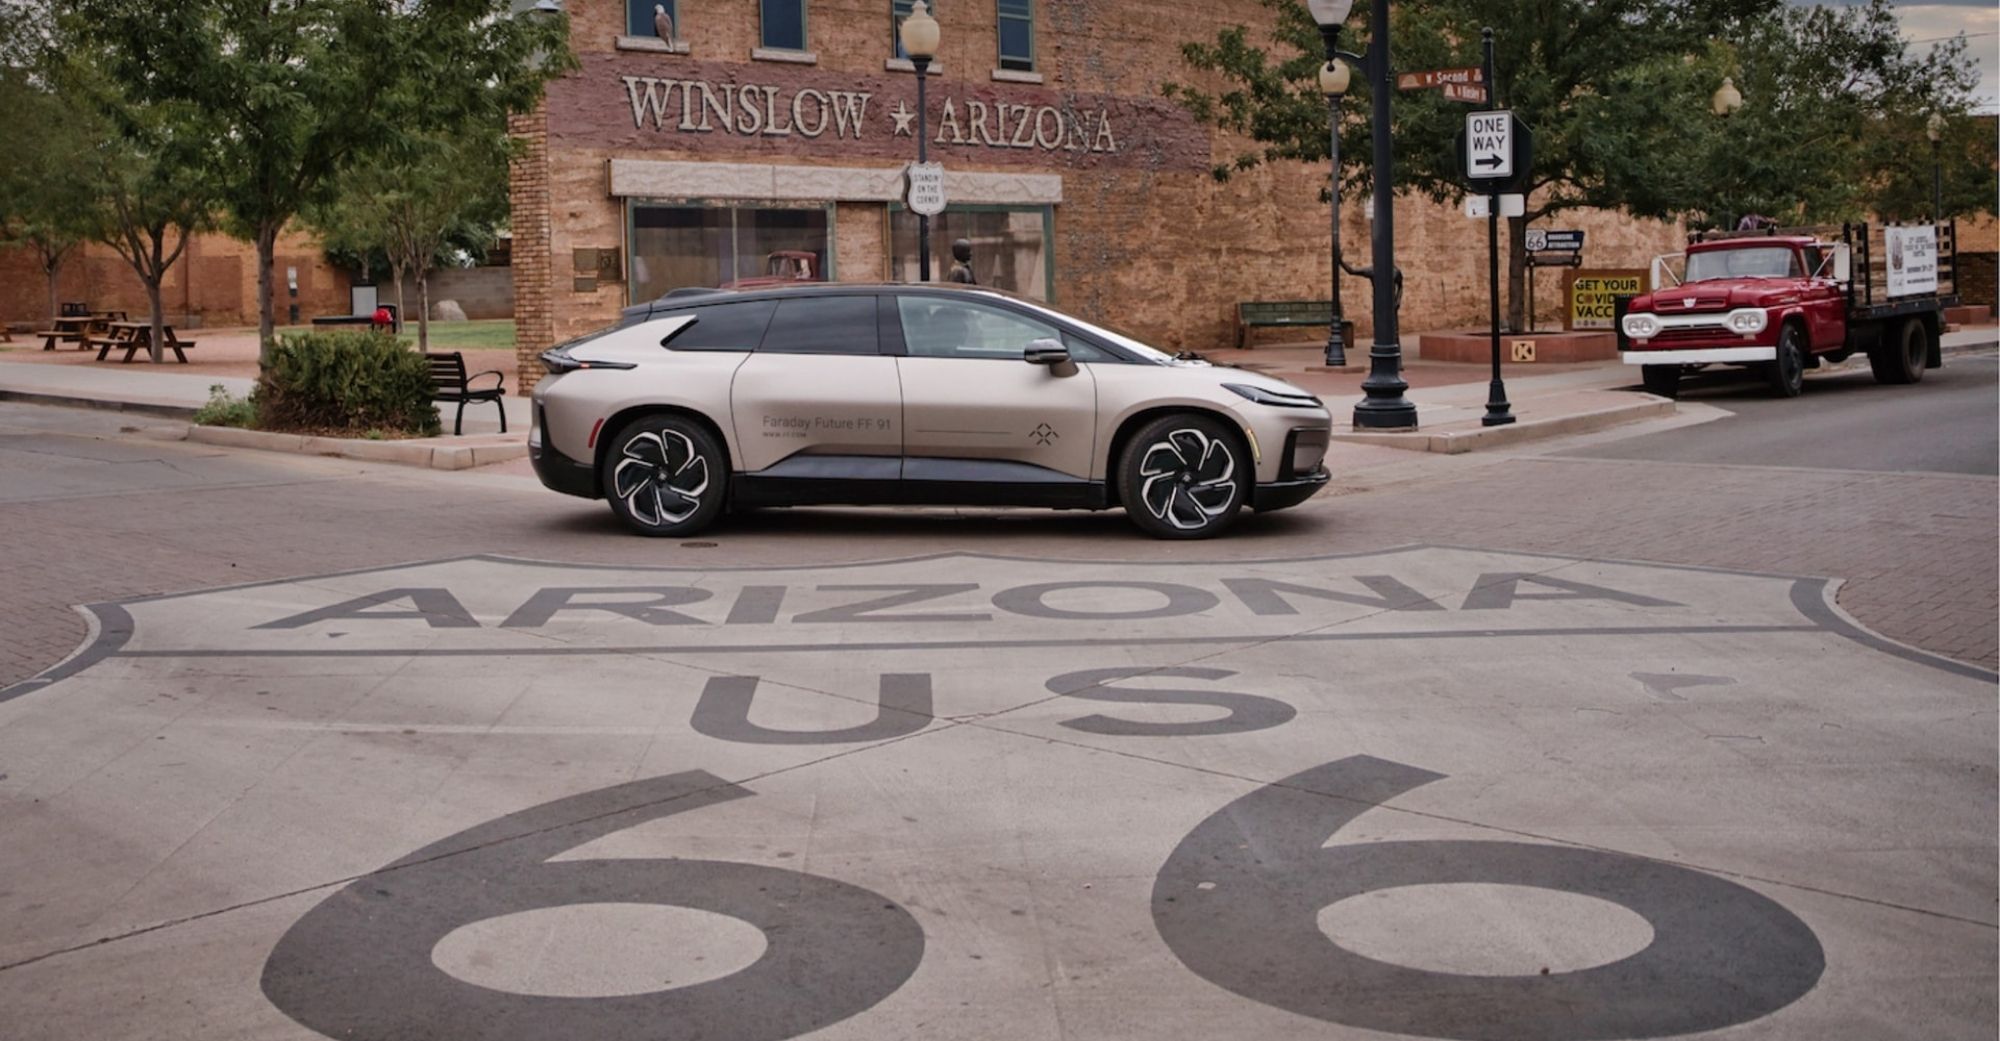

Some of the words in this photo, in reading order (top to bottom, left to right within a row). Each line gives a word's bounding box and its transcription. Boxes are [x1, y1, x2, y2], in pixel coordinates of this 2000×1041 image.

[1436, 70, 1469, 84] Second
[622, 76, 872, 139] WINSLOW
[933, 96, 1119, 152] ARIZONA
[1473, 118, 1505, 134] ONE
[1473, 135, 1506, 151] WAY
[927, 184, 938, 193] THE
[1527, 236, 1544, 249] 66
[1576, 280, 1600, 290] GET
[1603, 280, 1638, 290] YOUR
[1576, 306, 1613, 318] VACC
[762, 415, 811, 430] Faraday
[815, 416, 854, 429] Future
[857, 418, 873, 429] FF
[877, 419, 891, 430] 91
[246, 572, 1690, 630] ARIZONA
